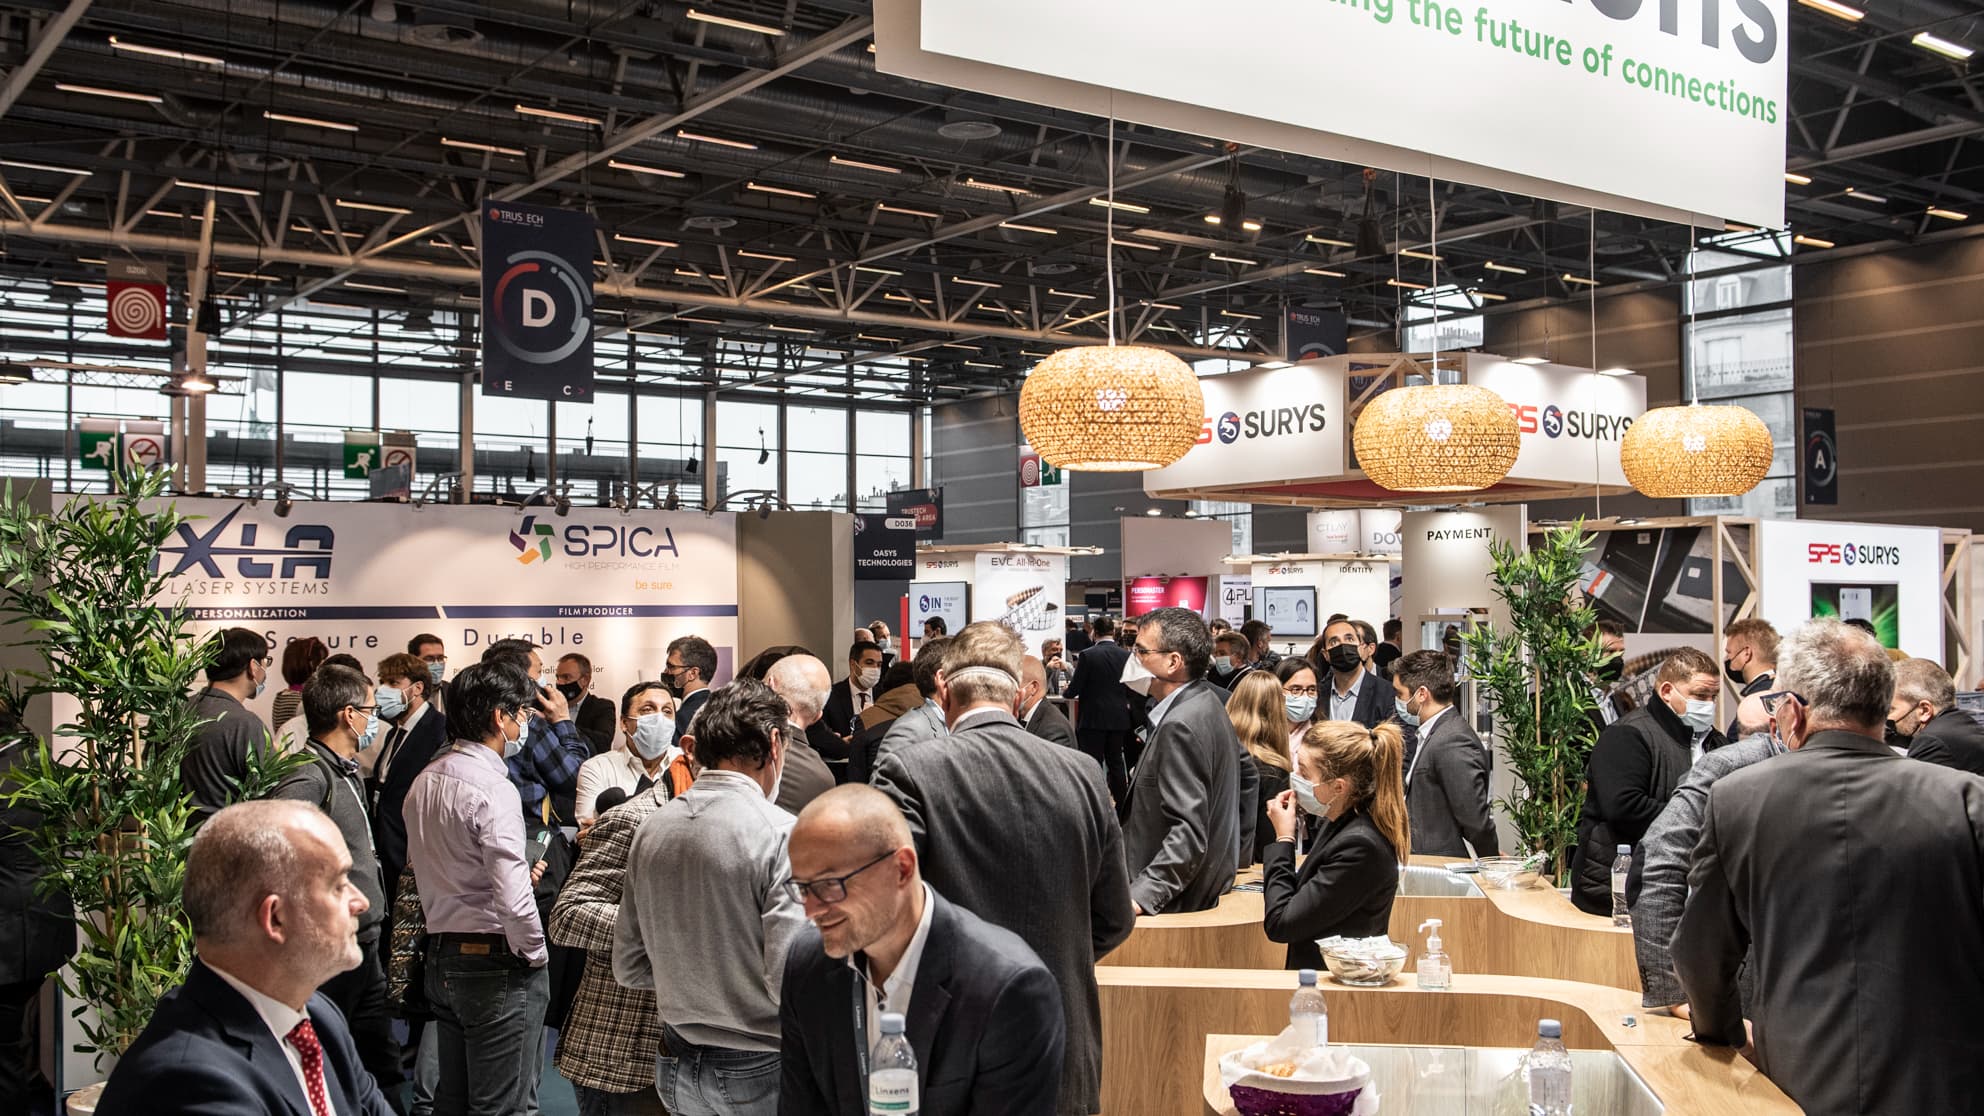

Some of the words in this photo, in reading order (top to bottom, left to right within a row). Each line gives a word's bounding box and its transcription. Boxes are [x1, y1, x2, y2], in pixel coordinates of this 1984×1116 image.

[1408, 0, 1463, 35] the
[1474, 7, 1572, 65] future
[1583, 44, 1613, 76] of
[1622, 58, 1777, 124] connections
[501, 210, 544, 224] TRUSECH
[522, 288, 556, 328] D
[504, 380, 513, 391] E
[562, 385, 572, 396] C
[1244, 403, 1326, 439] SURYS
[1567, 410, 1633, 441] SURYS
[1815, 449, 1826, 469] A
[563, 524, 679, 558] SPICA
[1427, 527, 1491, 541] PAYMENT
[873, 549, 898, 557] OASYS
[1808, 543, 1841, 563] SPS
[1858, 545, 1900, 565] SURYS
[858, 559, 913, 567] TECHNOLOGIES
[991, 557, 1013, 566] EVC
[1339, 566, 1373, 574] IDENTITY
[242, 581, 329, 595] SYSTEMS
[635, 580, 648, 590] be
[651, 581, 673, 590] sure
[194, 608, 307, 618] PERSONALIZATION
[264, 630, 380, 650] Sure
